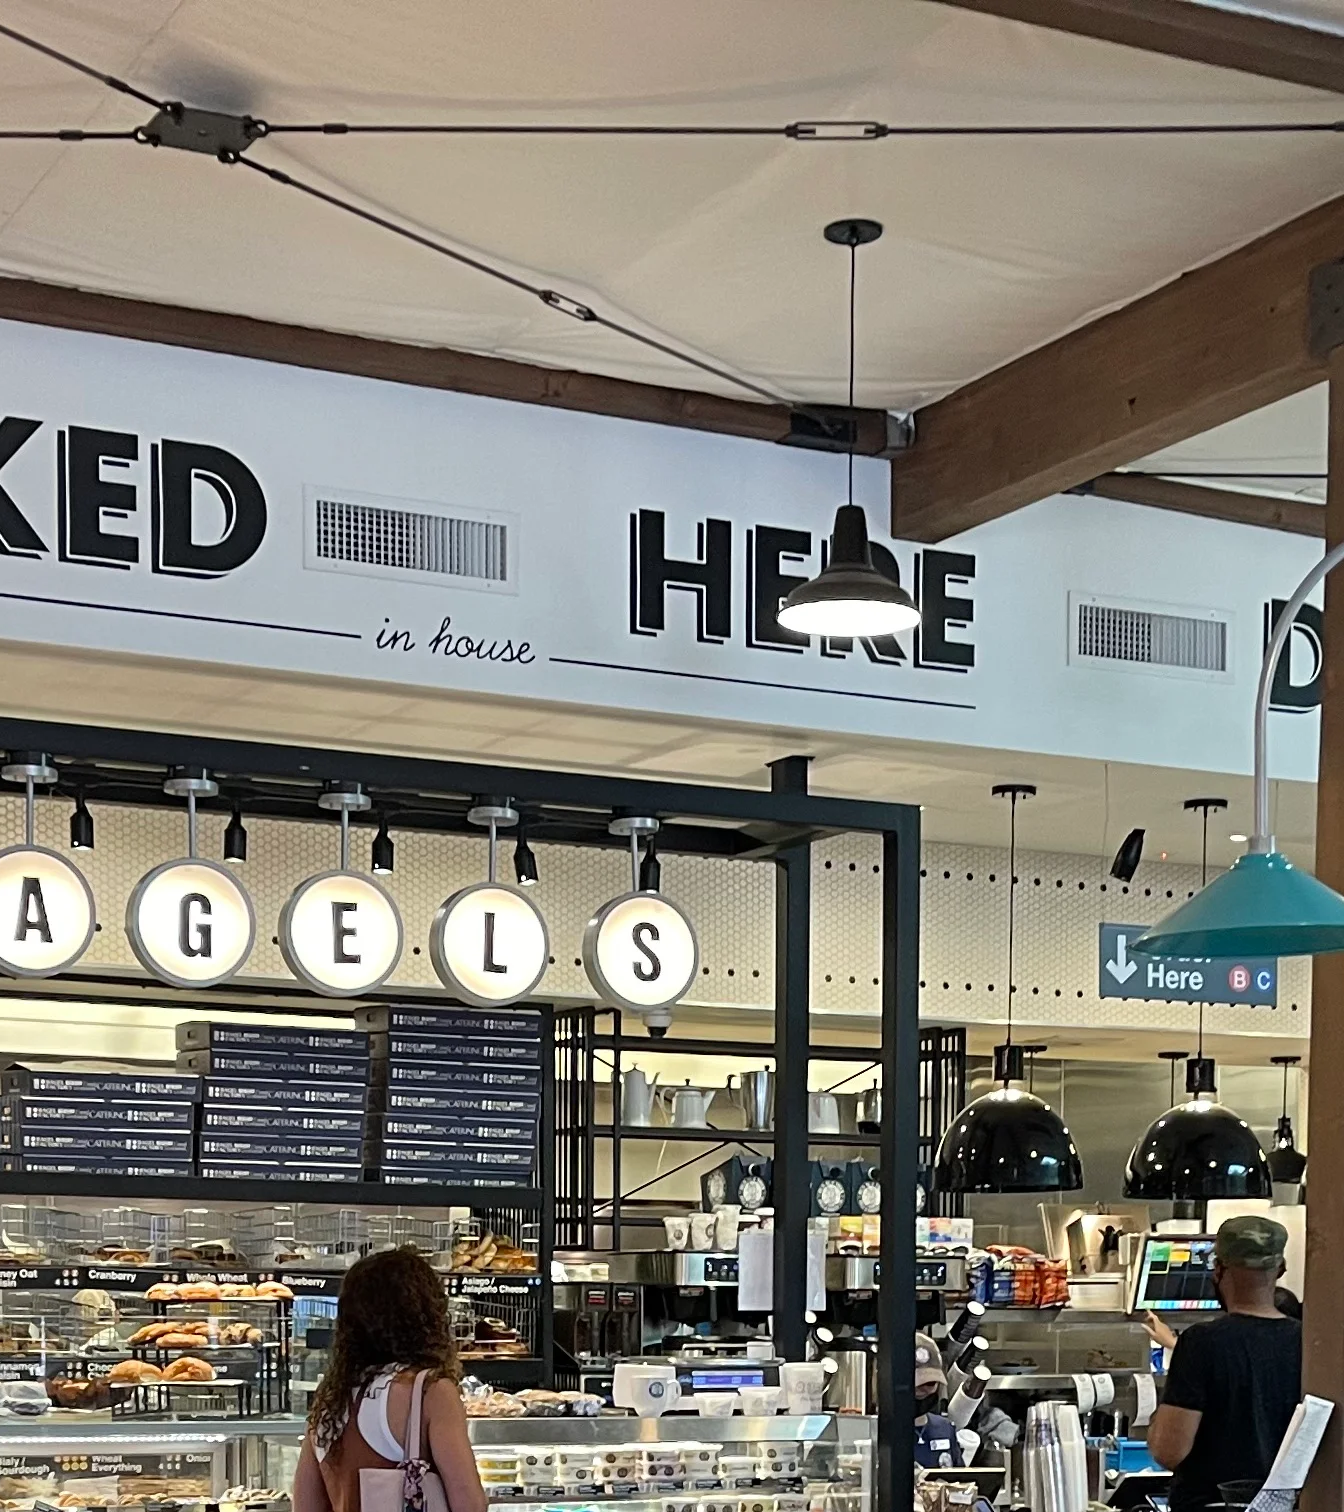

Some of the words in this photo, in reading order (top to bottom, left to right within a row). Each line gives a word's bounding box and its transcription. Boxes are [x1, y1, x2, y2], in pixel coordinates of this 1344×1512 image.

[376, 617, 416, 652] in
[429, 617, 537, 664] house
[1147, 963, 1204, 991] Here
[1233, 971, 1246, 988] B
[1257, 971, 1271, 990] C
[19, 1269, 38, 1279] Oat
[88, 1270, 137, 1282] Cranberry
[218, 1274, 248, 1283] Wheat
[282, 1276, 326, 1288] Blueberry
[461, 1278, 490, 1287] Asiago
[499, 1286, 529, 1294] Cheese
[92, 1455, 122, 1463] Wheat
[92, 1463, 142, 1473] Everything
